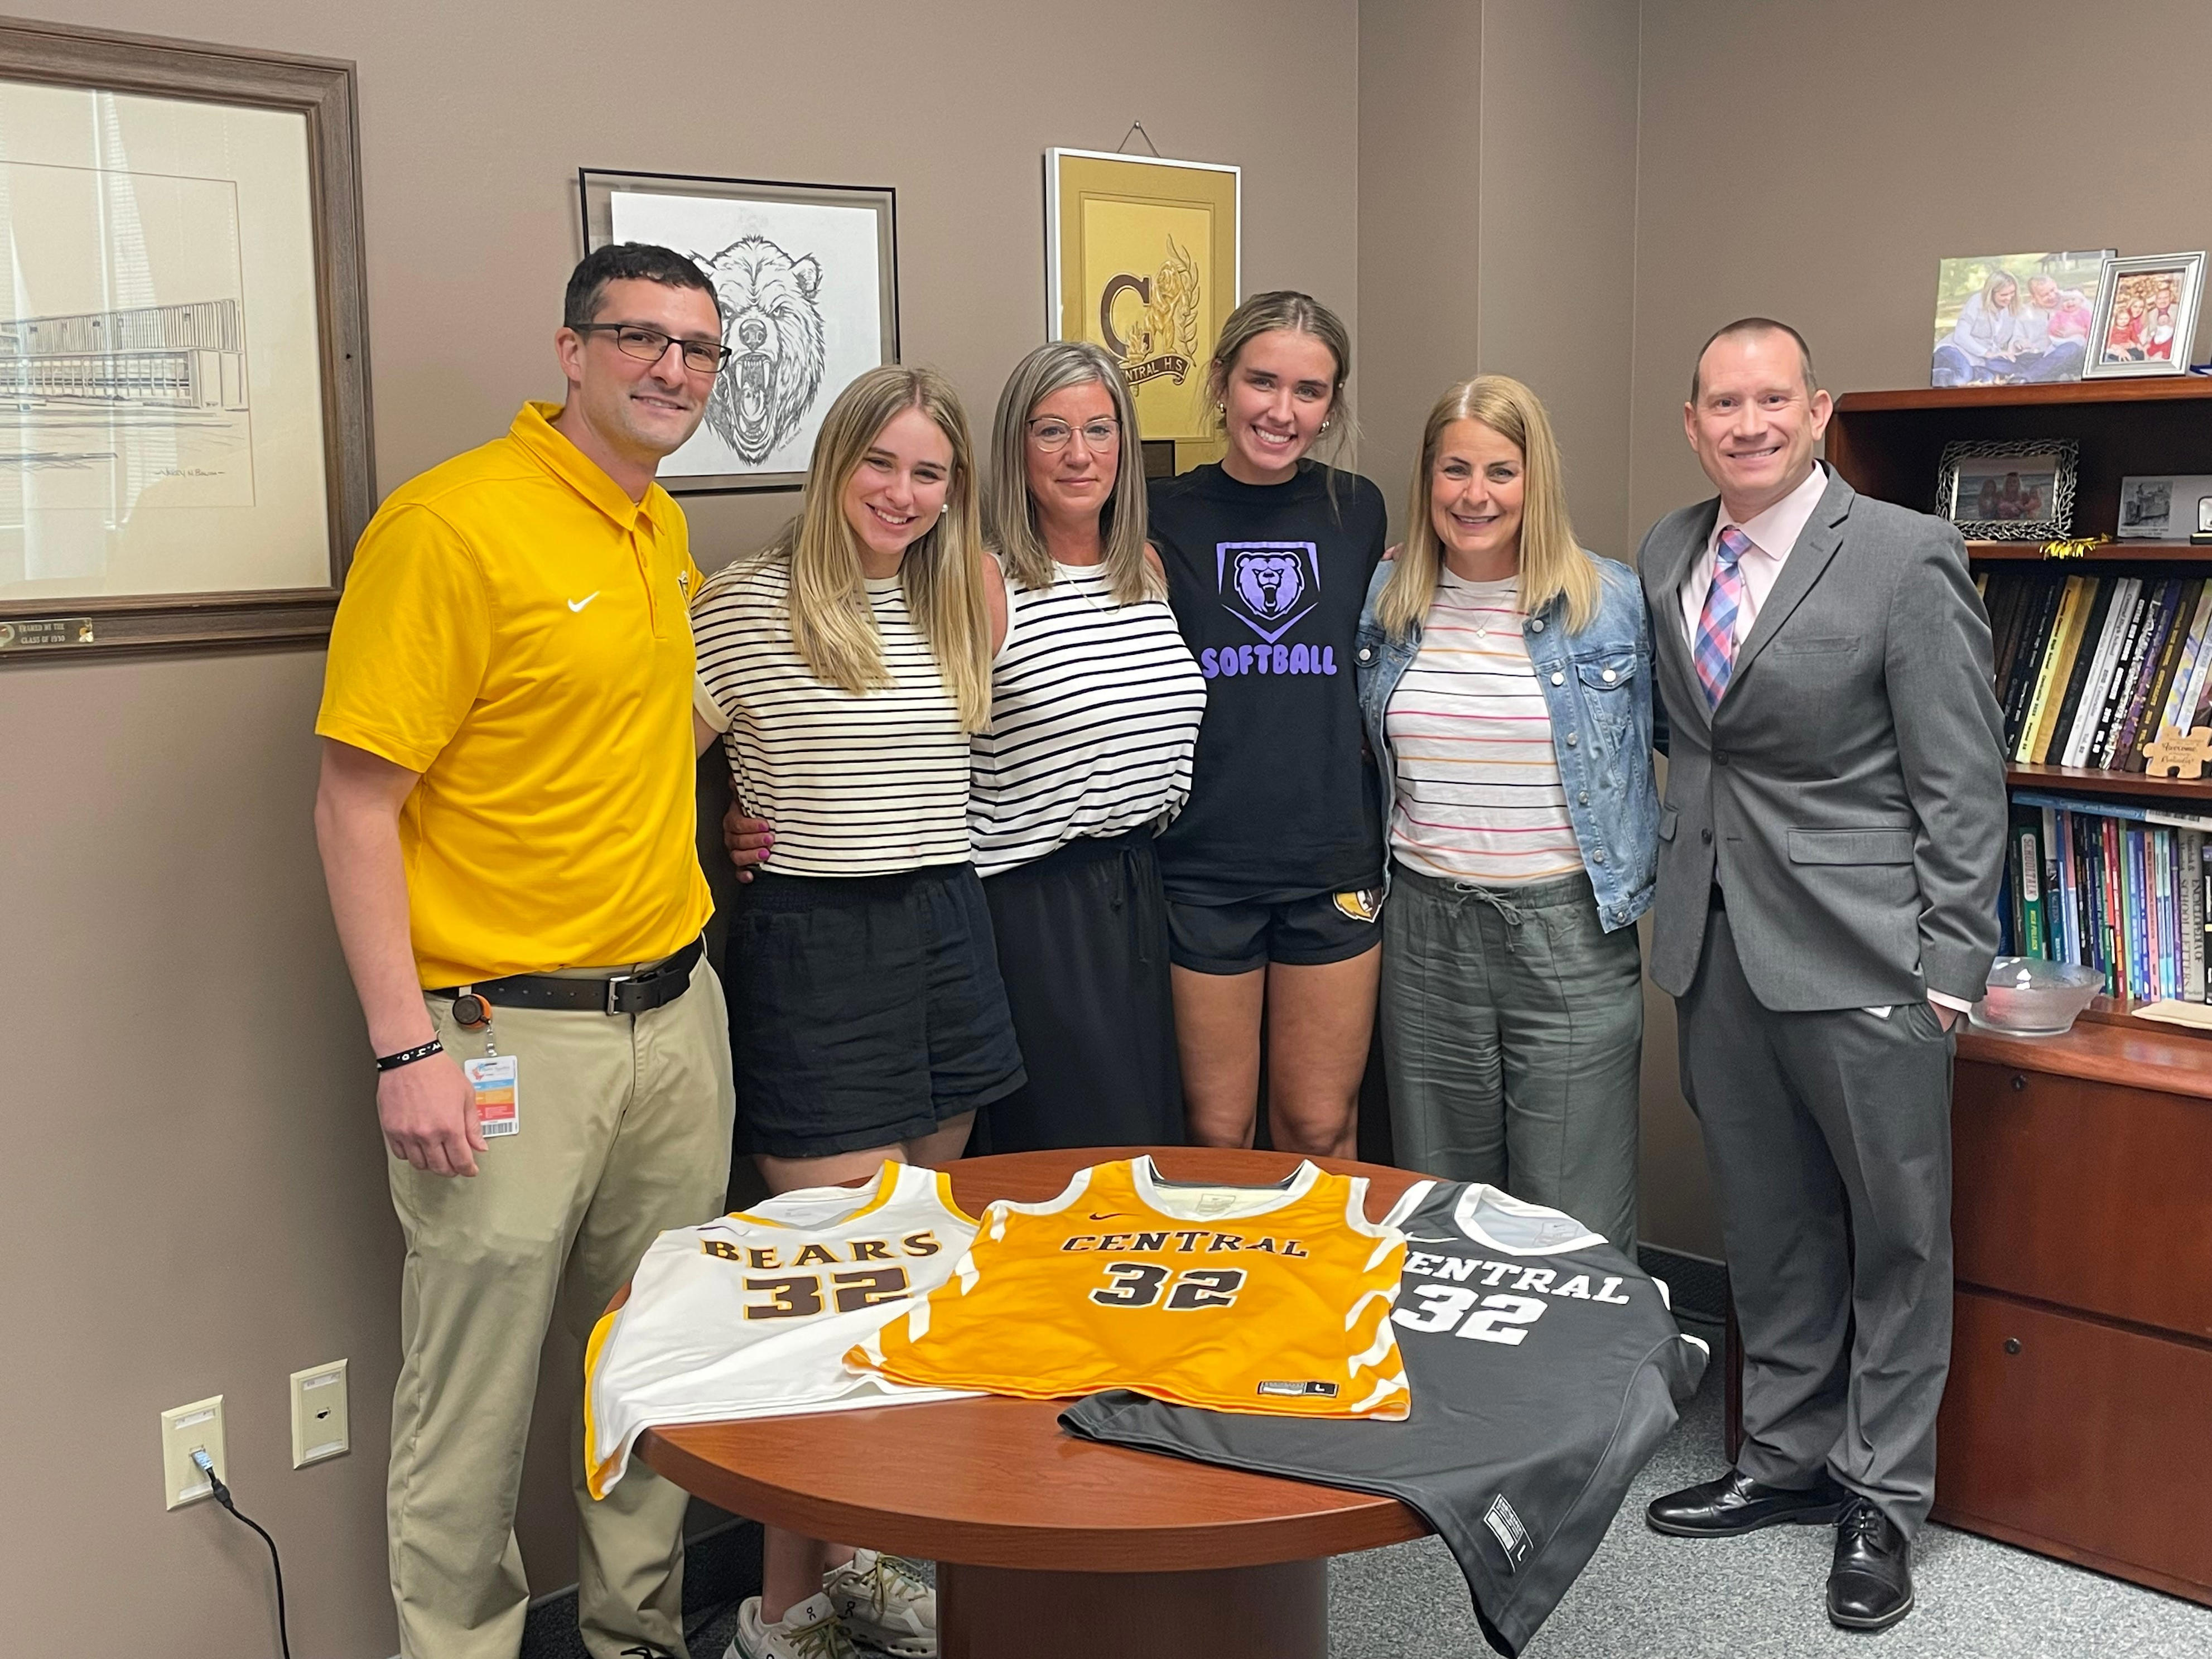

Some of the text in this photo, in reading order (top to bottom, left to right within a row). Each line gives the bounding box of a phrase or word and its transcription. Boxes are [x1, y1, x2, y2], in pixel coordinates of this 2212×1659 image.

[1201, 643, 1337, 679] SOFTBALL
[2022, 837, 2038, 897] SCHOOLTALK
[2180, 879, 2191, 987] SCHOOL LETTERS
[2191, 879, 2203, 963] ENCYCLOPEDIA OF
[701, 1231, 943, 1270] BEARS
[1061, 1231, 1309, 1257] CENTRAL
[743, 1265, 913, 1320] 32
[1088, 1261, 1247, 1311] 32
[1402, 1251, 1630, 1305] ENTRAL
[1390, 1284, 1548, 1346] 32
[1315, 1383, 1325, 1392] L
